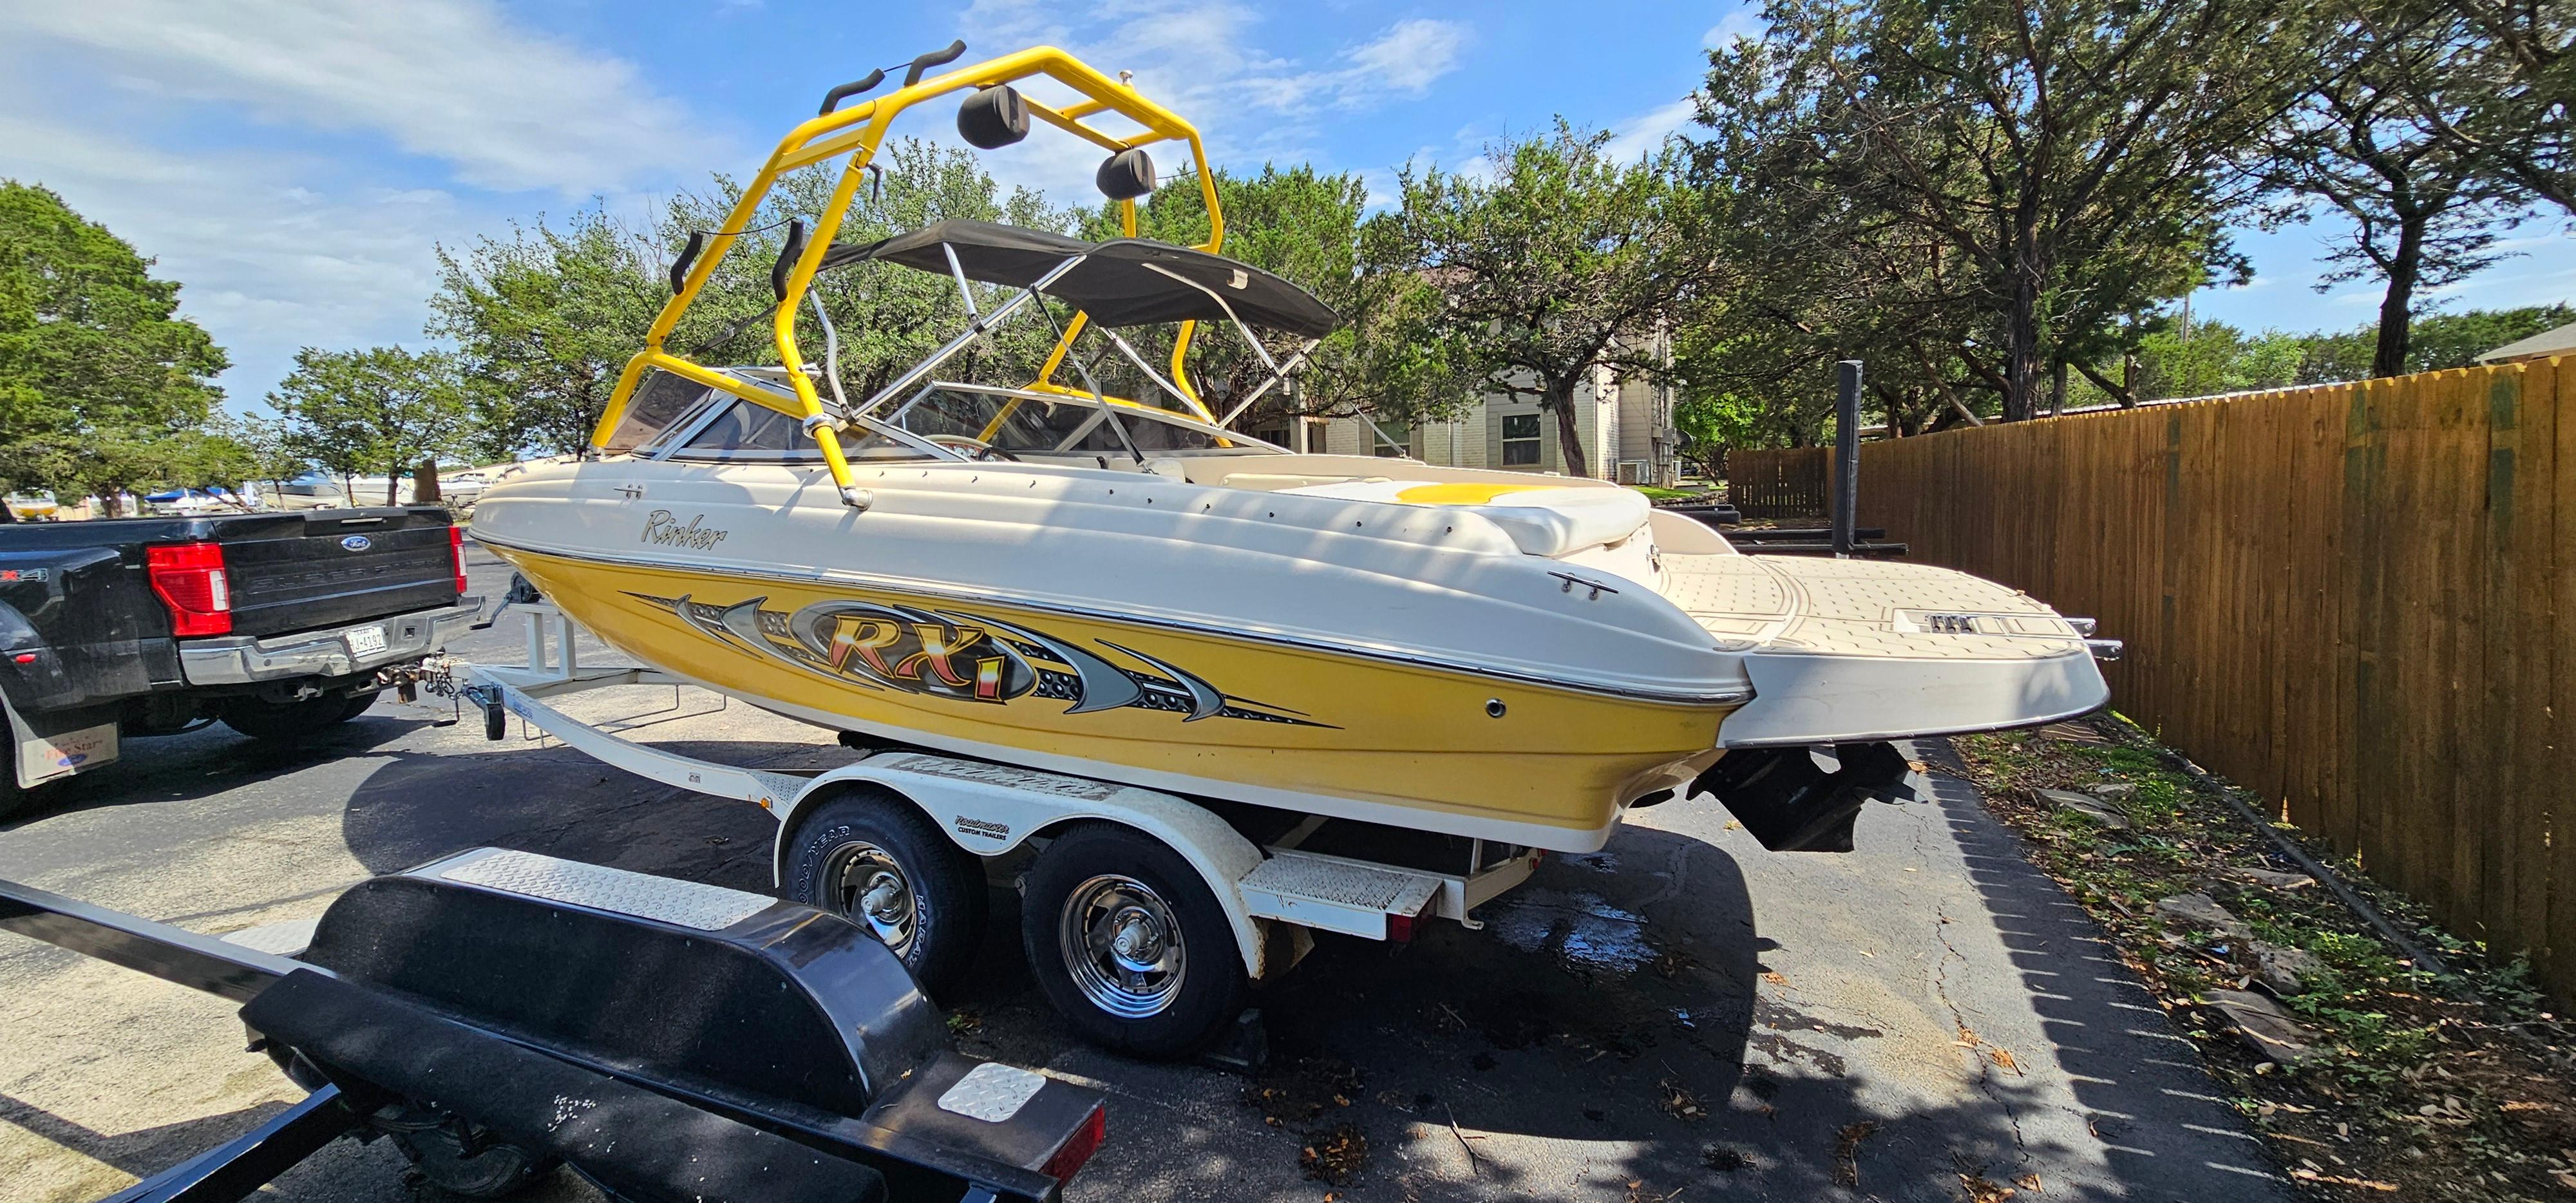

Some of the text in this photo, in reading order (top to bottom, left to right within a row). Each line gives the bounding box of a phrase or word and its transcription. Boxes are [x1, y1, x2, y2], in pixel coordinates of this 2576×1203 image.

[641, 509, 728, 551] Rinker
[955, 815, 1010, 834] Roadmaster
[958, 827, 1007, 840] CUSTOM TRAILERS
[799, 826, 849, 905] OODYEAR
[908, 895, 927, 967] MARAT
